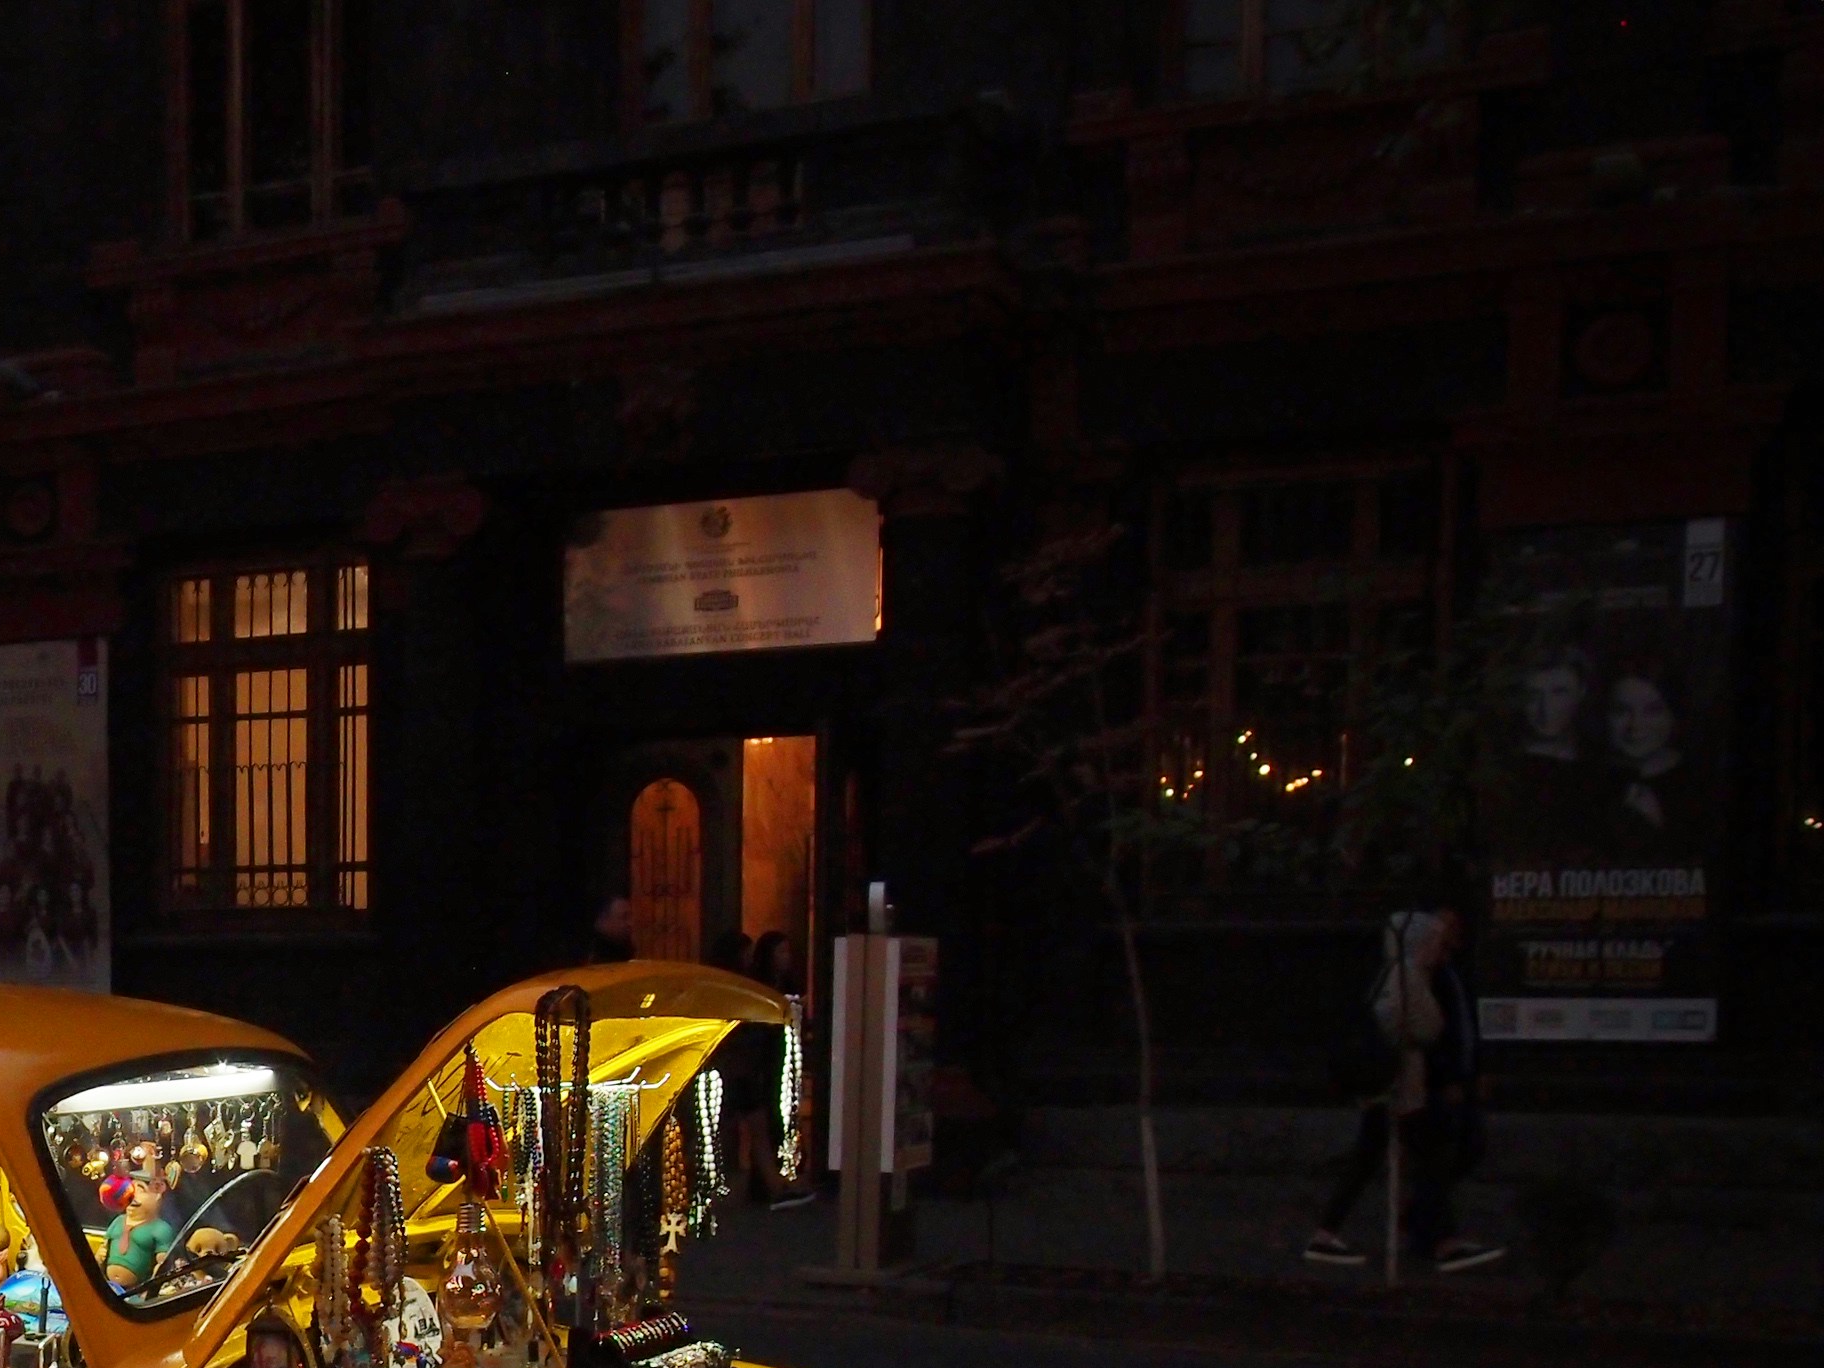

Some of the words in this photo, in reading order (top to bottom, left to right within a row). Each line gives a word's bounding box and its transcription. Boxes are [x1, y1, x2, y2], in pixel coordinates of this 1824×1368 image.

[1689, 551, 1721, 582] 27
[77, 672, 97, 696] 30
[1491, 870, 1554, 899] ВЕРА
[1558, 866, 1708, 898] ПОЛОЗКОВА
